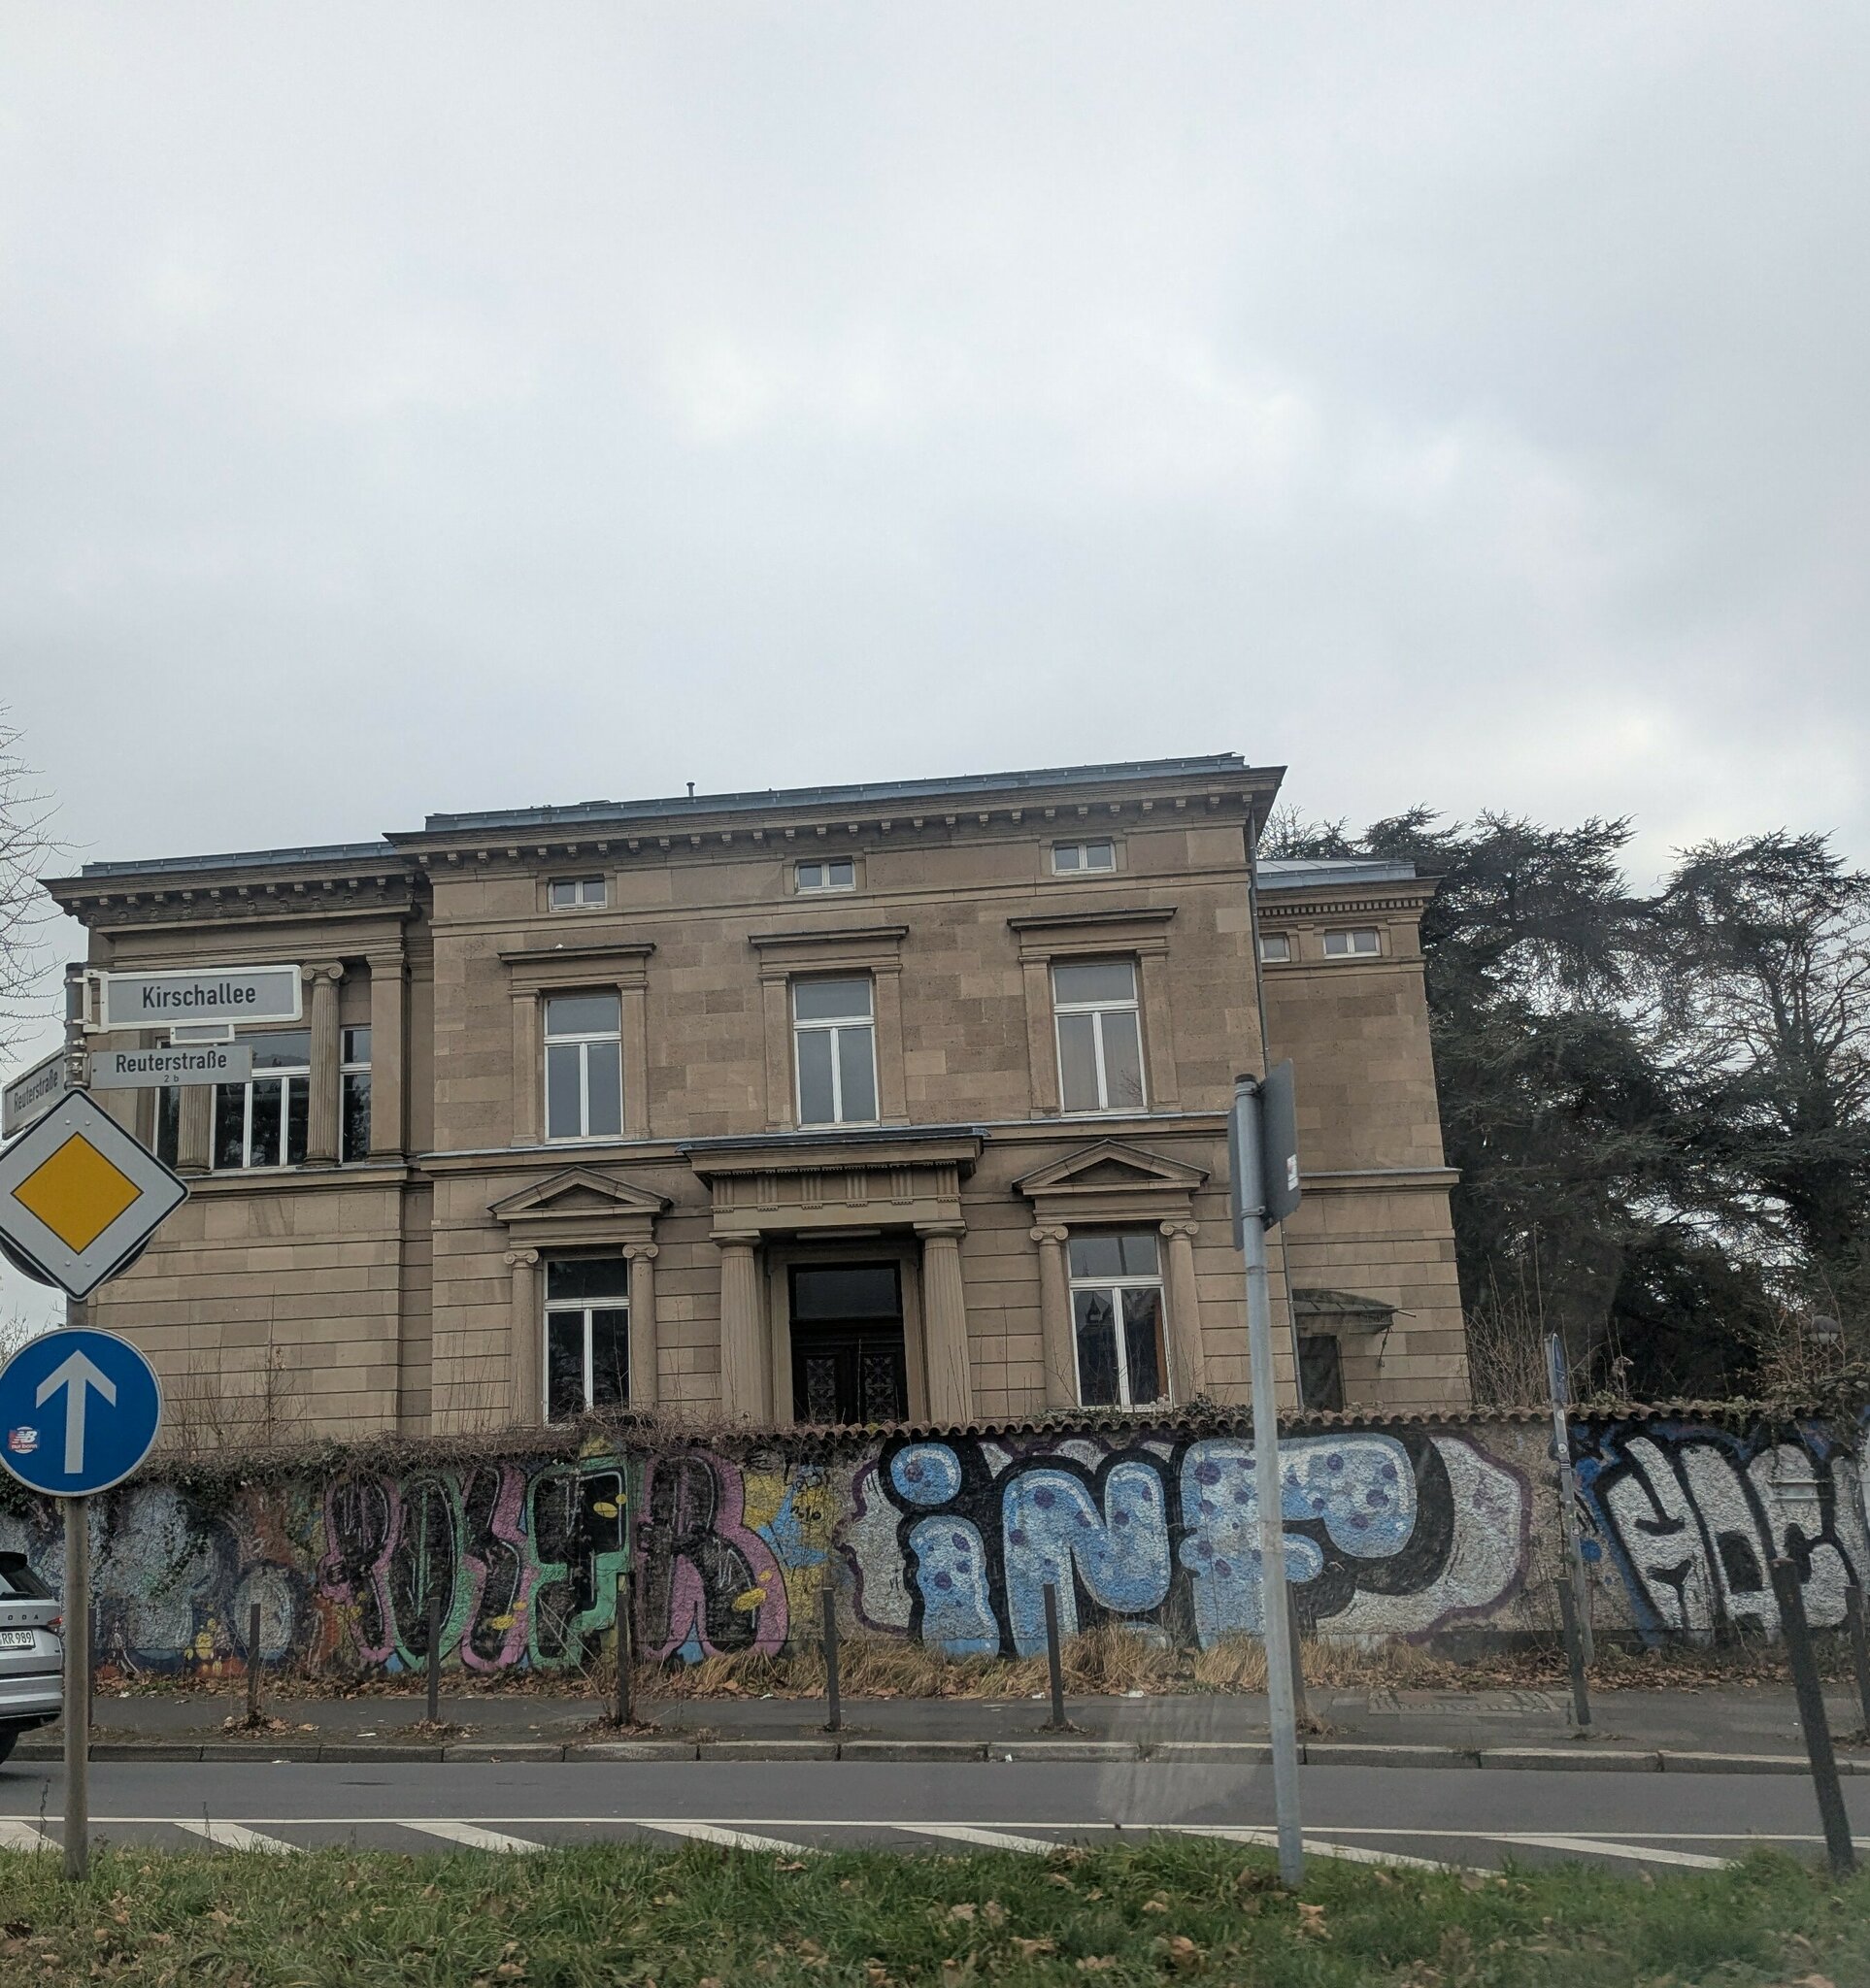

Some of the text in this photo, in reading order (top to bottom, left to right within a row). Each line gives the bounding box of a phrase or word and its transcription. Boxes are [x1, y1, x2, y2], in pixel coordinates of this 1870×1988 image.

[143, 982, 256, 1009] Kirschallee
[116, 1050, 227, 1073] Reuterstraße
[14, 1069, 58, 1113] Reuterstraße
[15, 1632, 32, 1644] 989
